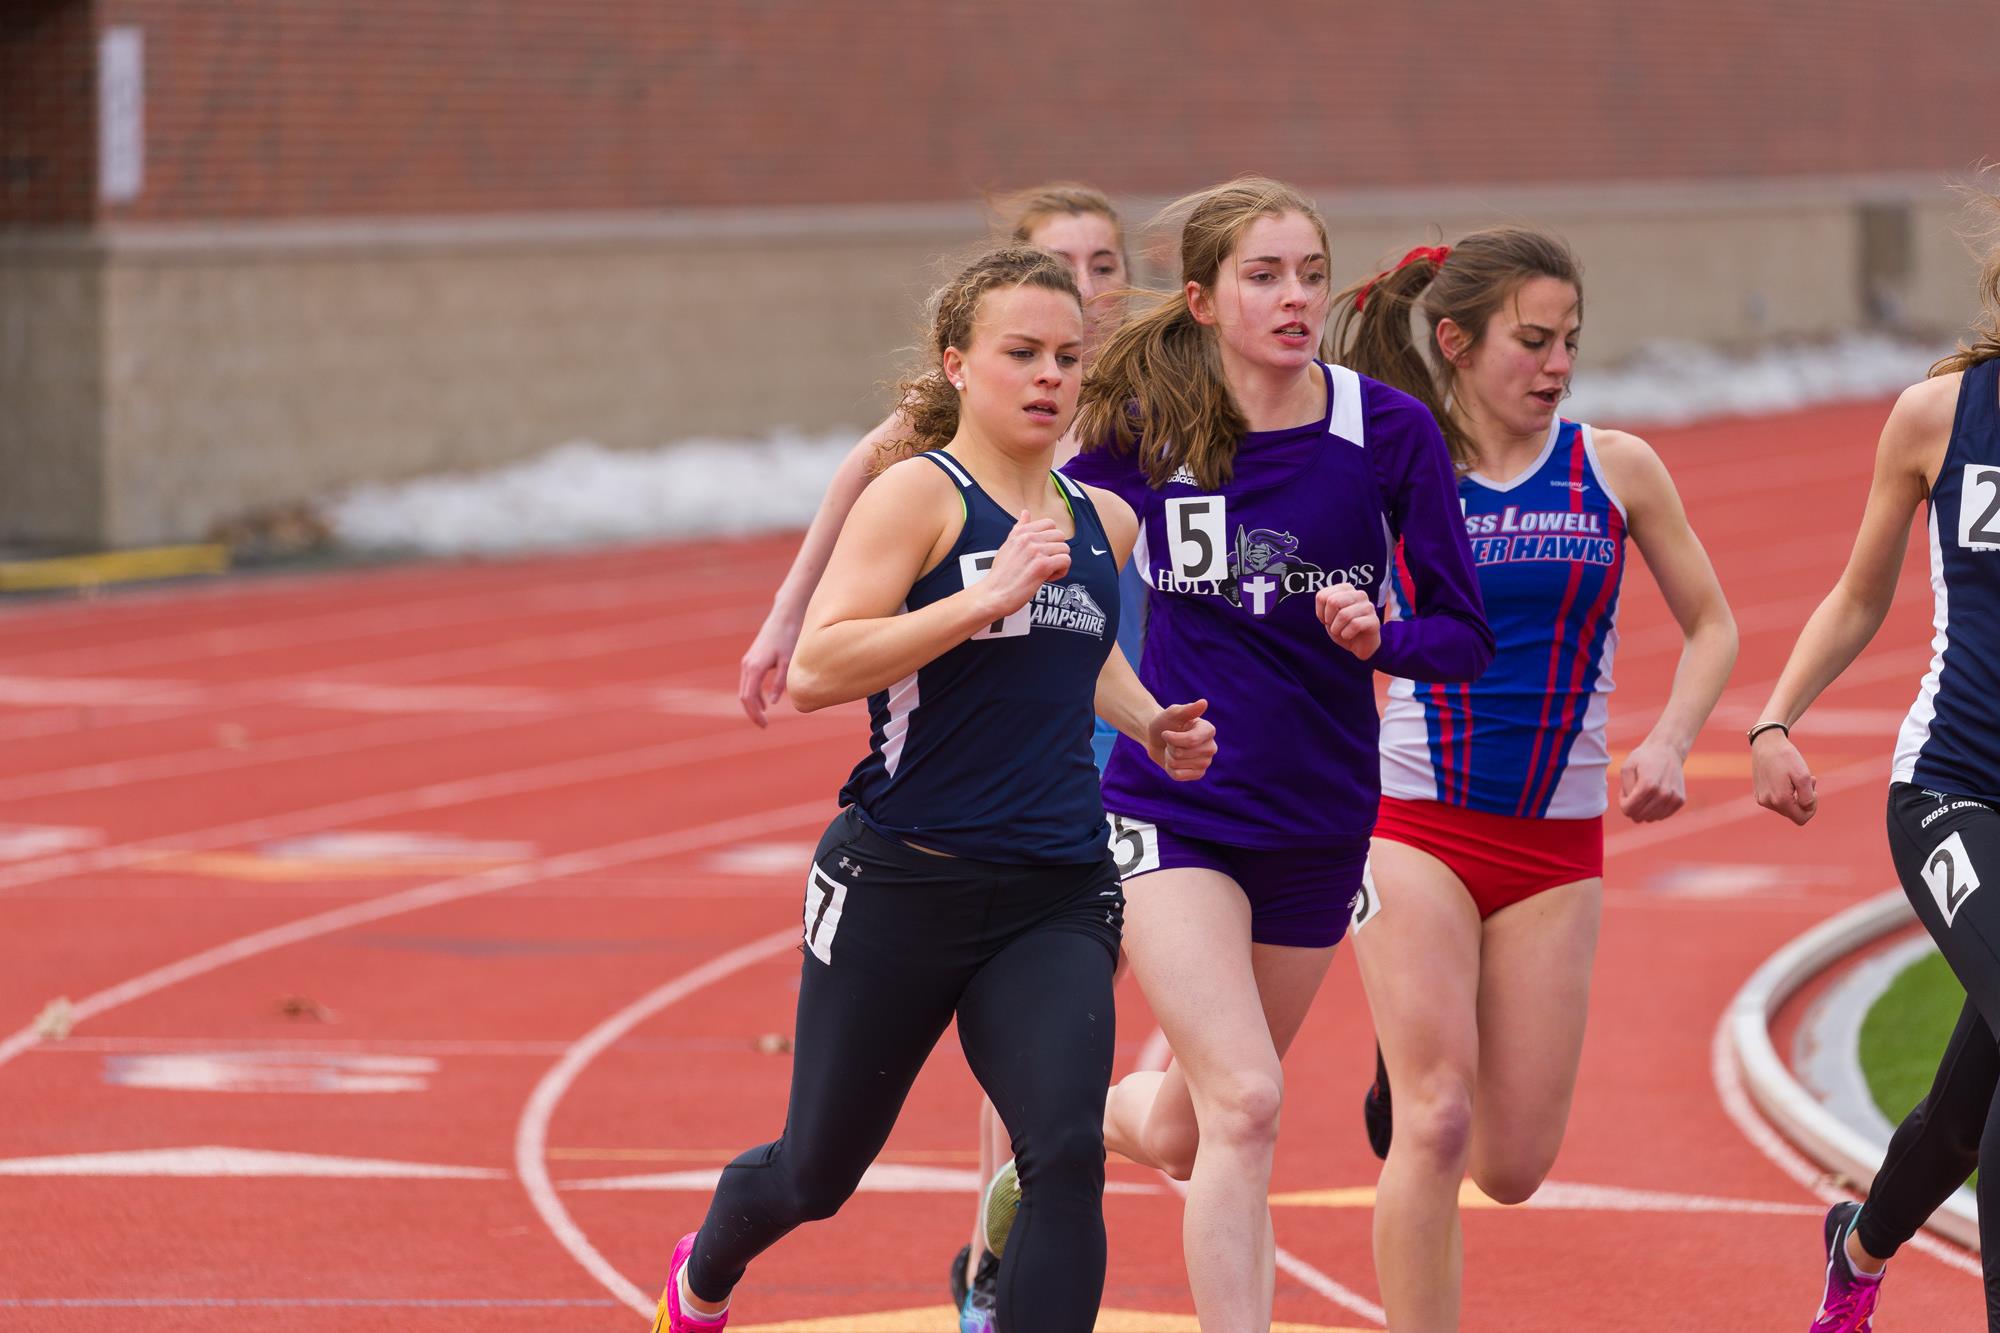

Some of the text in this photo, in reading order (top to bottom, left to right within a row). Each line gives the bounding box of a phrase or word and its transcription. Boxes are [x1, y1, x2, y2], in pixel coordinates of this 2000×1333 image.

[1465, 506, 1601, 535] SS LOWELL
[1968, 470, 2000, 544] 2
[1179, 502, 1213, 578] 5
[1511, 535, 1615, 566] HAWKS
[1284, 564, 1374, 594] CROSS
[1033, 584, 1065, 606] EW
[1030, 604, 1105, 634] AMPSHIRE
[1921, 800, 1994, 829] CROSS COUNT
[1113, 814, 1144, 876] 5
[1930, 849, 1969, 915] 2
[810, 873, 835, 947] 7
